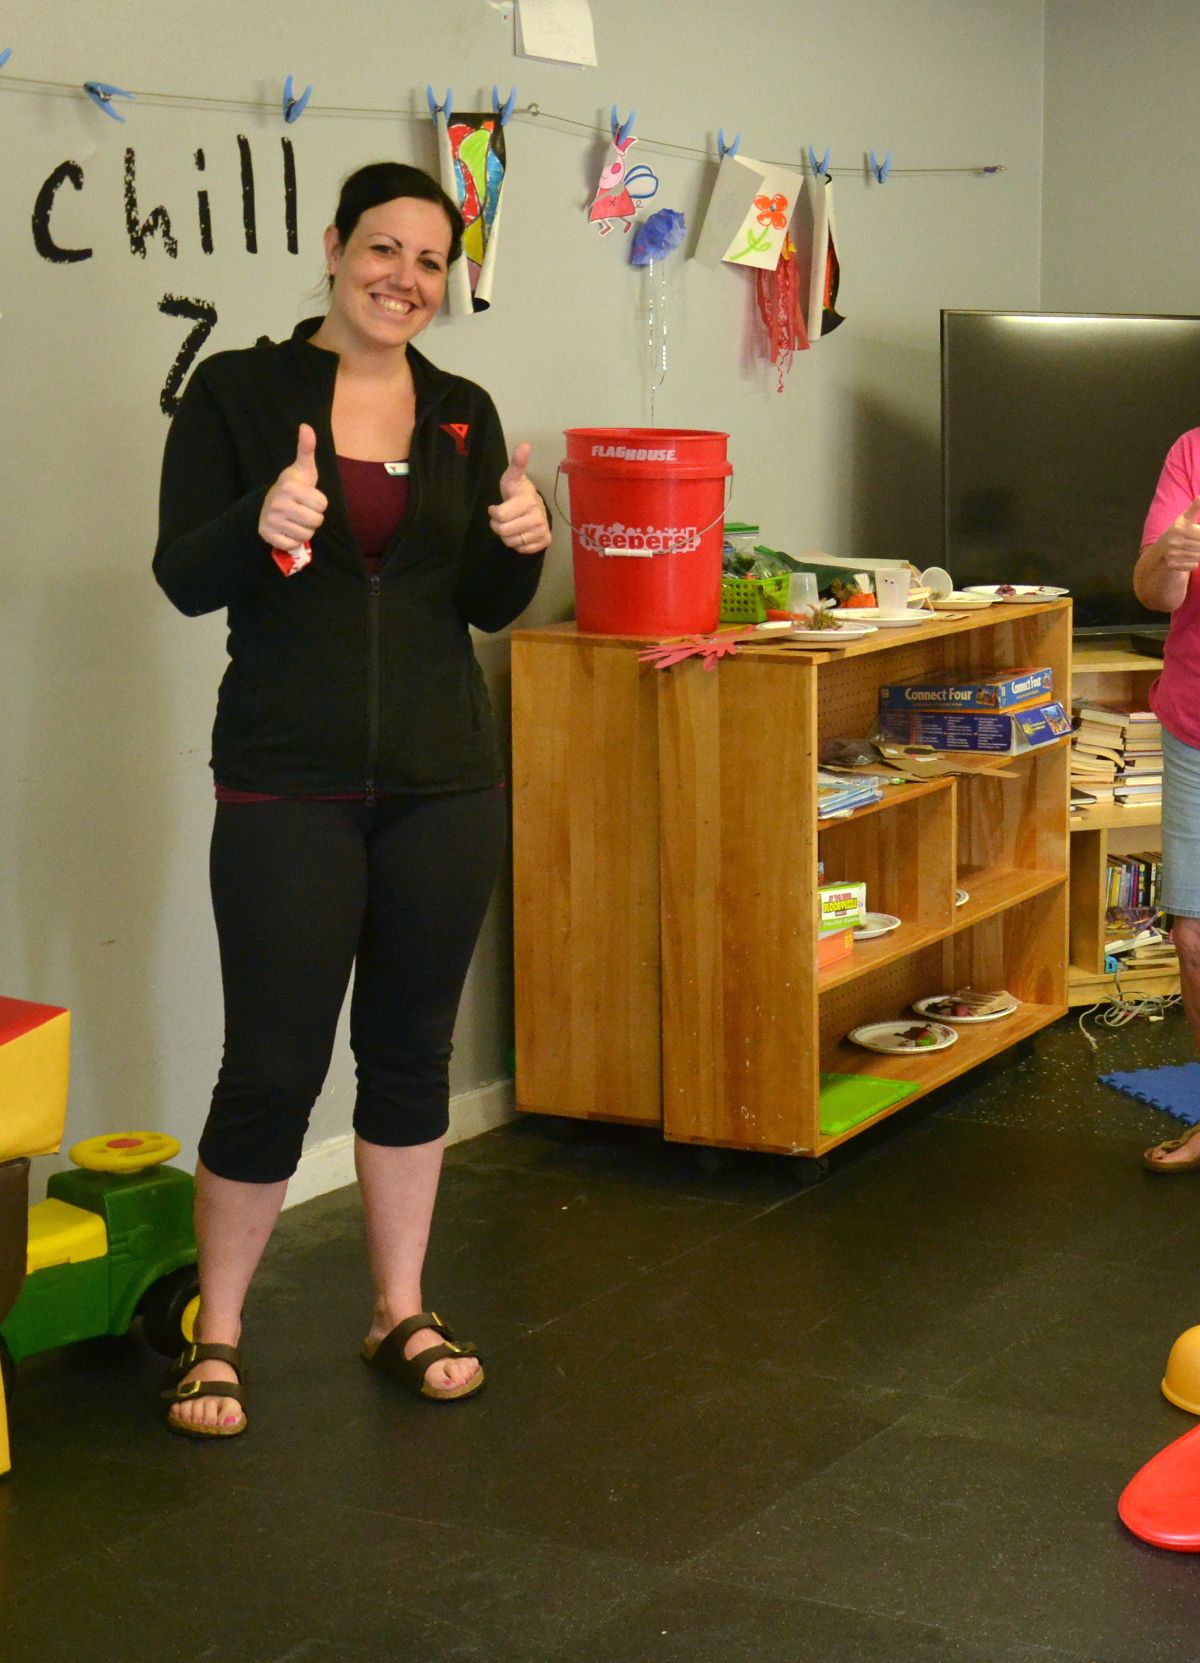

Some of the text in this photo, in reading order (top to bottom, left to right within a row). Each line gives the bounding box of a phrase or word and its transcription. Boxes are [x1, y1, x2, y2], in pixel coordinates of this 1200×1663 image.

[591, 445, 677, 461] FLAGHOUSE
[581, 524, 699, 555] Keepers!
[905, 687, 947, 701] Connect
[949, 687, 973, 701] Four
